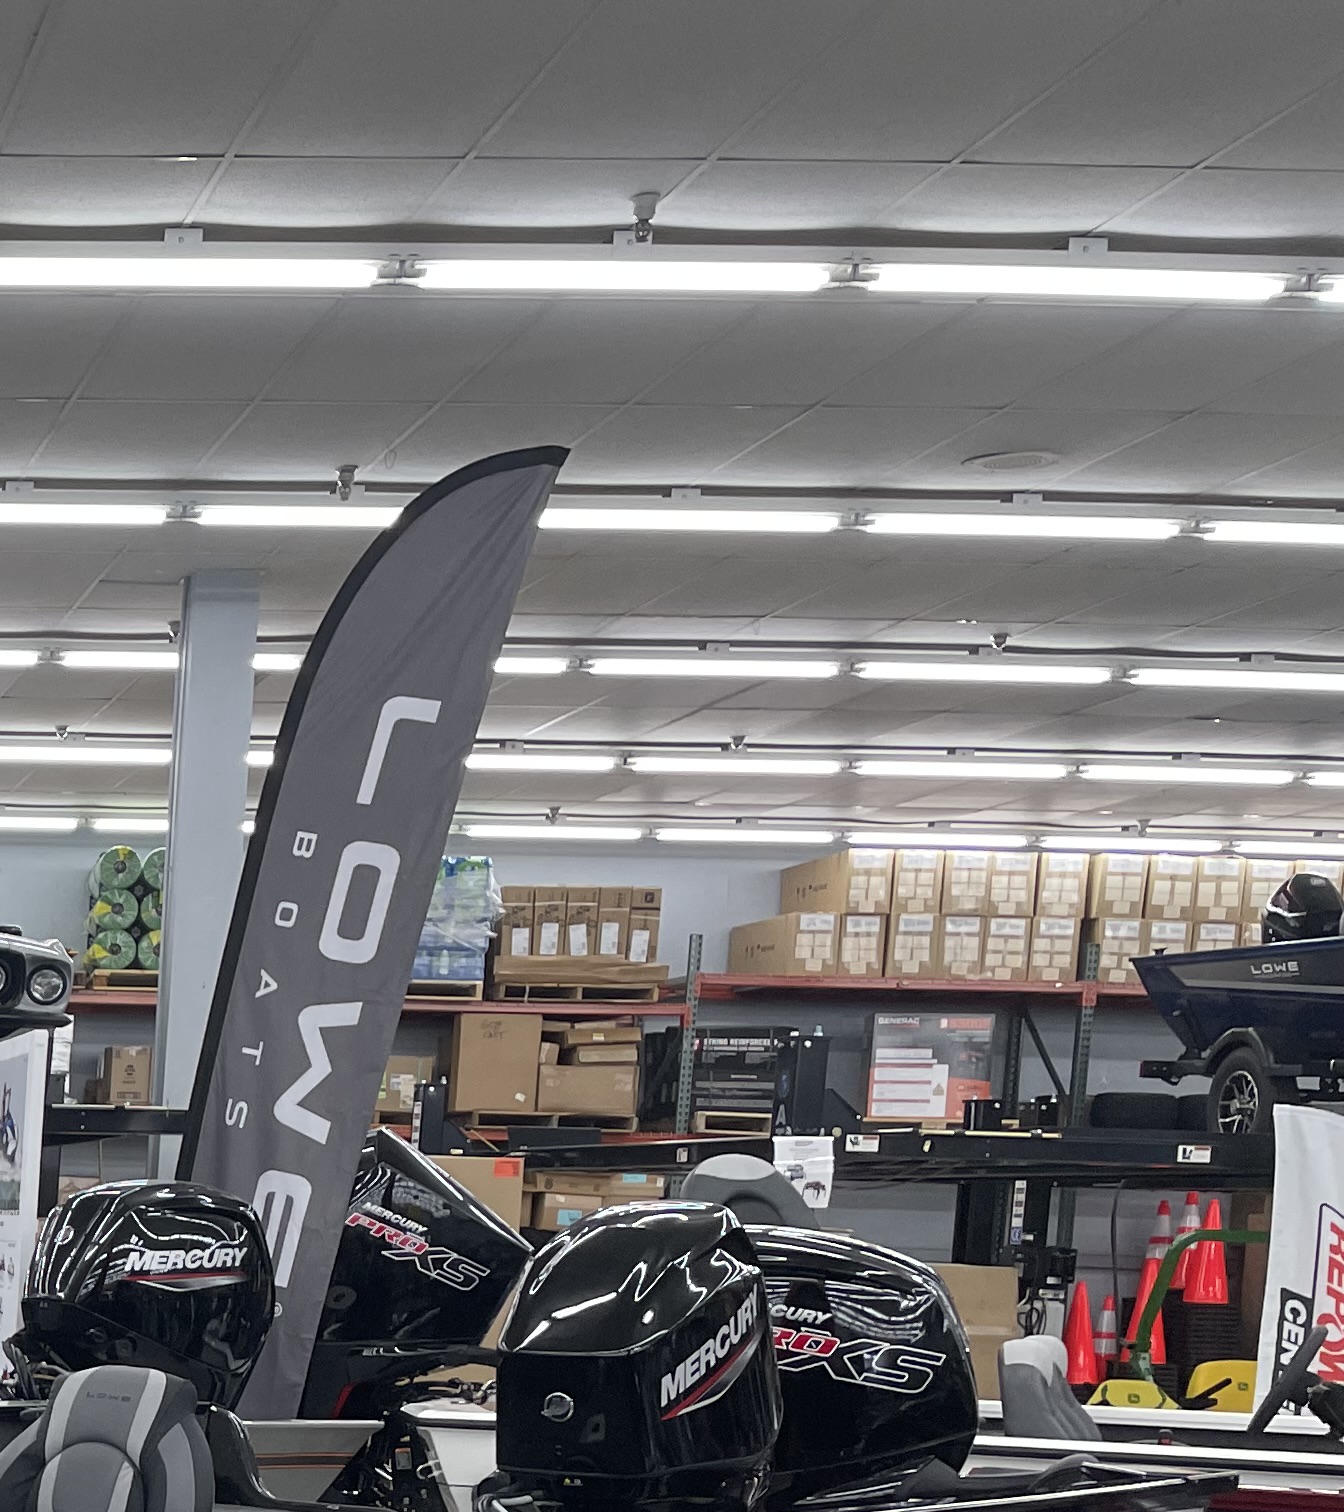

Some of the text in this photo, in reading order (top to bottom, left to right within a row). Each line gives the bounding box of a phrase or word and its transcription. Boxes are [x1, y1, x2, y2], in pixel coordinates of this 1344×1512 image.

[225, 830, 318, 1129] BOATS
[1250, 961, 1299, 975] LOWE
[253, 695, 442, 1288] LOWE
[344, 1211, 430, 1255] PRO
[362, 1201, 429, 1234] MERCURY
[123, 1246, 248, 1272] MERCURY
[380, 1246, 491, 1291] XS
[771, 1304, 833, 1325] CURY
[660, 1282, 758, 1408] MERCURY
[770, 1326, 841, 1358] RO
